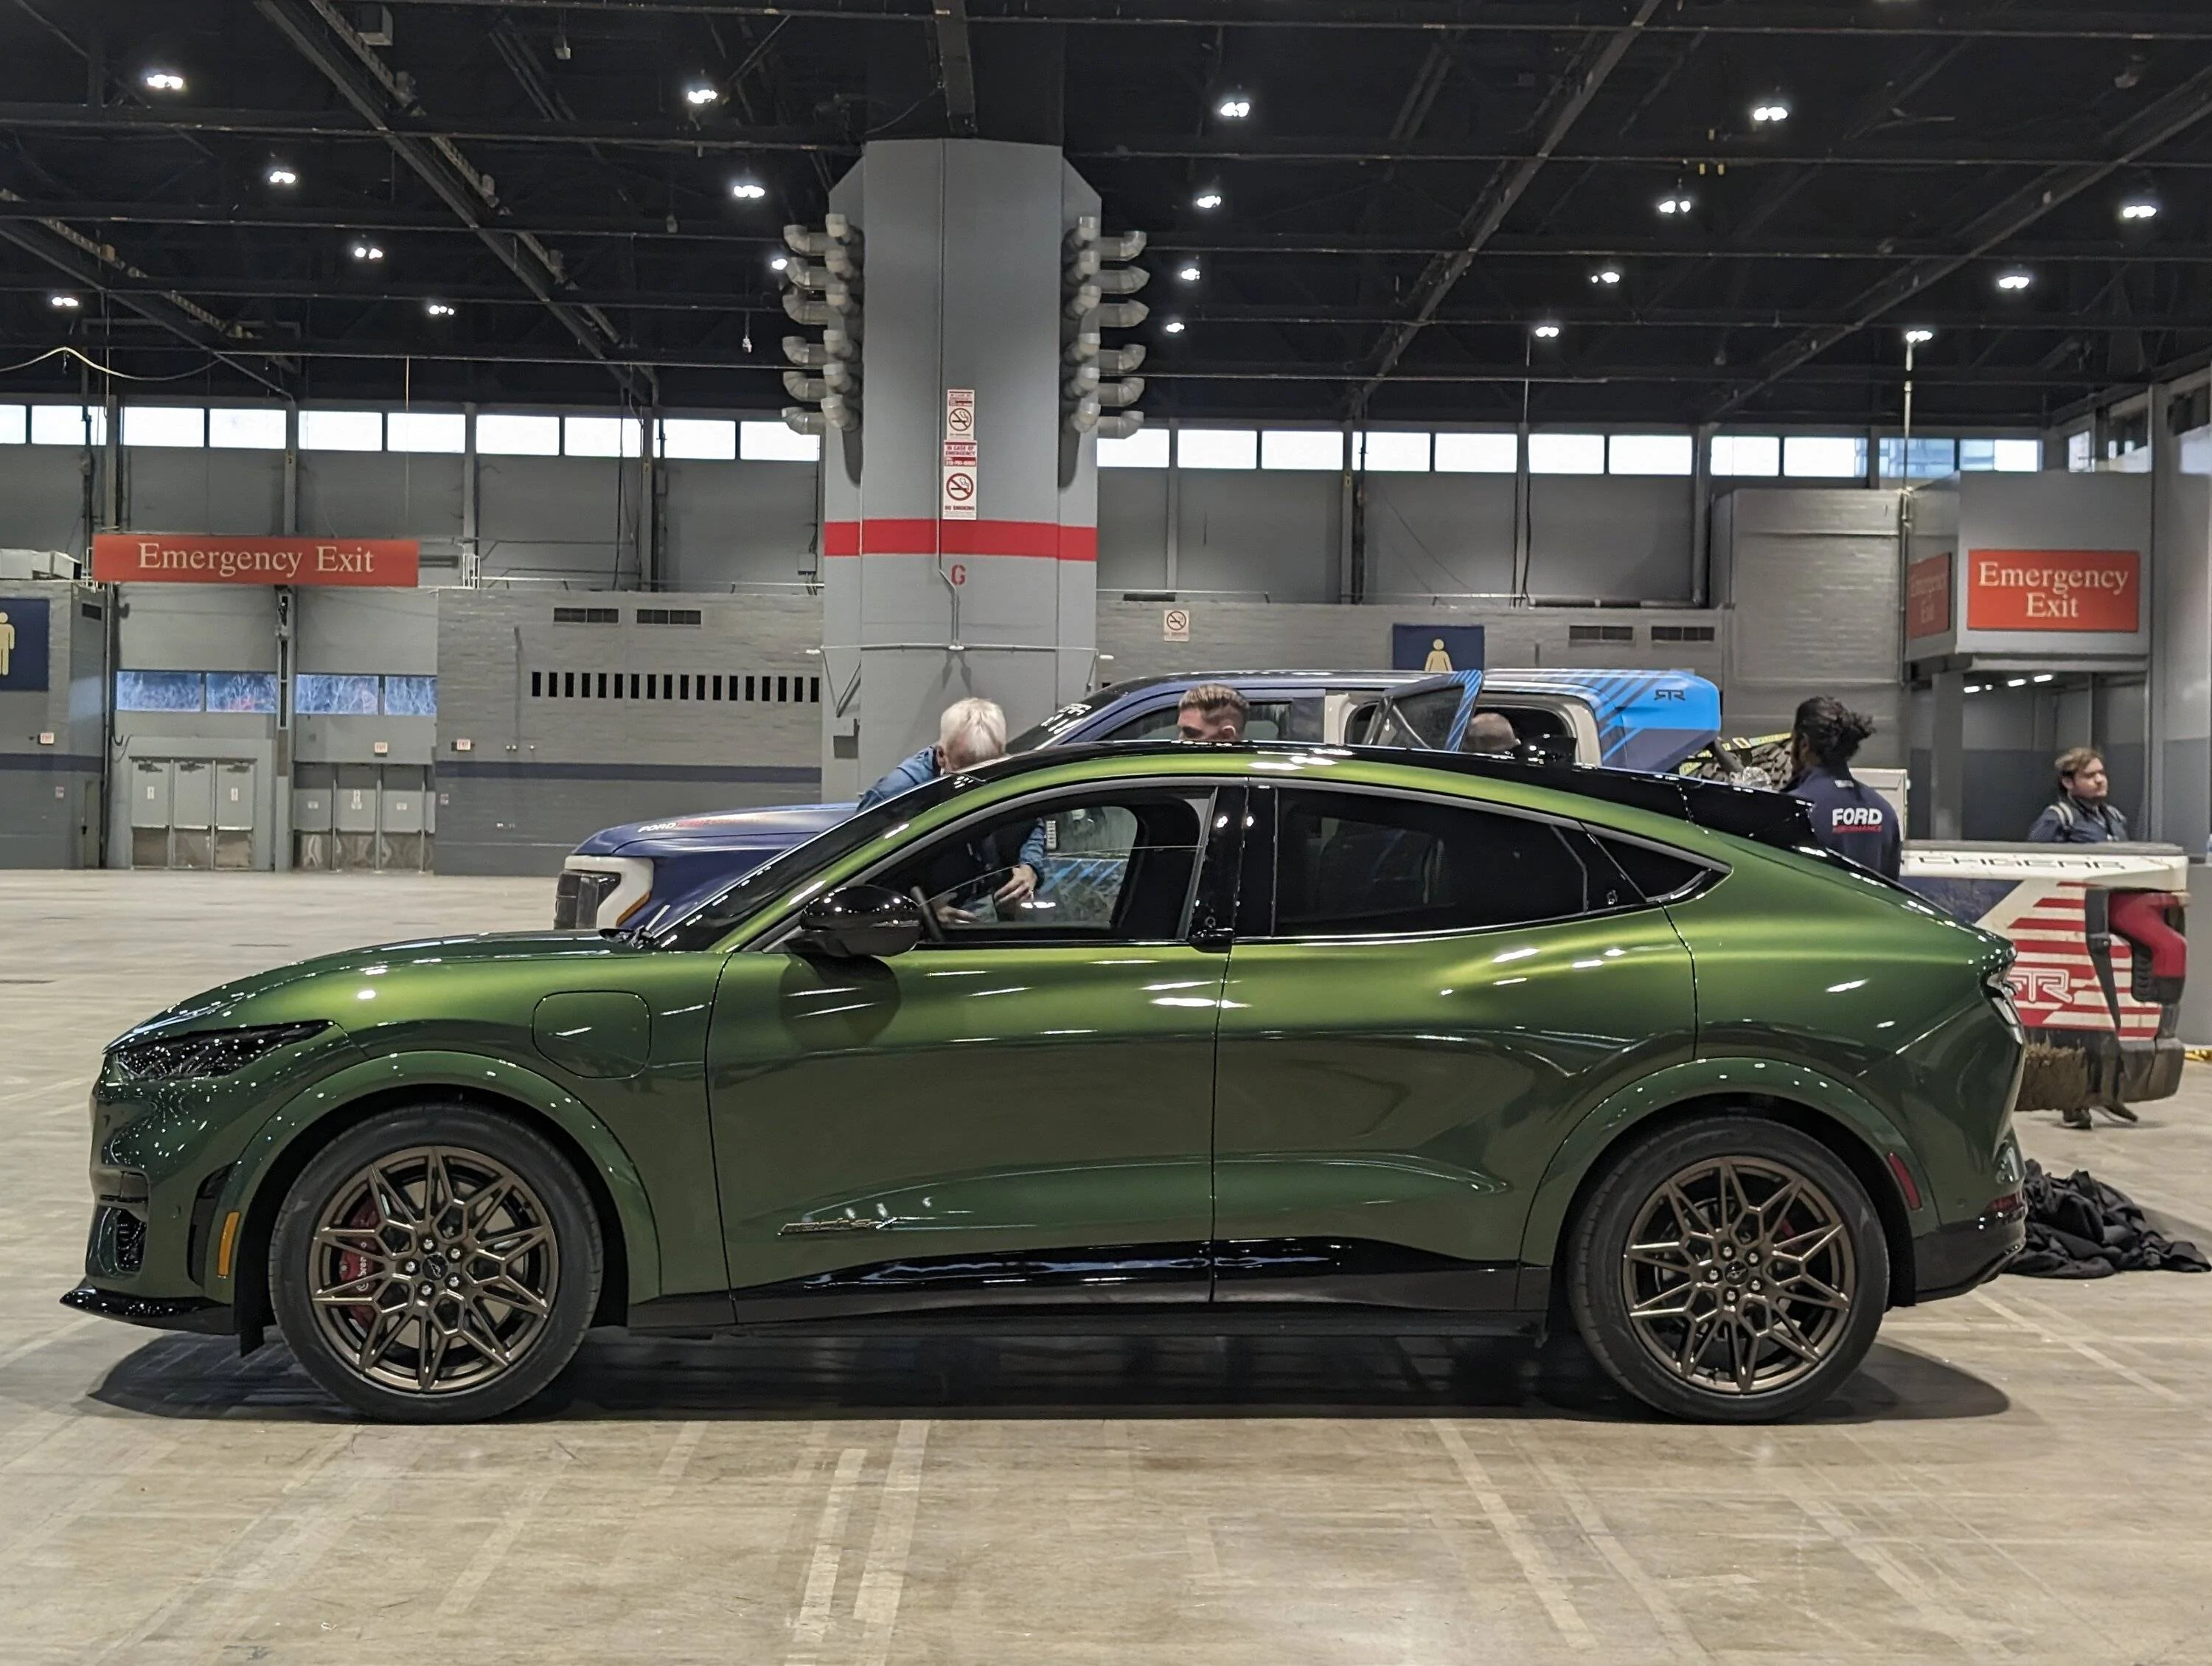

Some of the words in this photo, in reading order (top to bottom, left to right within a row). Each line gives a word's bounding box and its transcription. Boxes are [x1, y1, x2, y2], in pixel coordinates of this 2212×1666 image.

[138, 543, 303, 577] Emergency
[316, 546, 375, 573] Exit
[951, 564, 966, 586] G
[1978, 561, 2129, 595] Emergency
[2026, 592, 2079, 618] Exit
[638, 822, 677, 833] FORD
[1832, 808, 1882, 826] FORD
